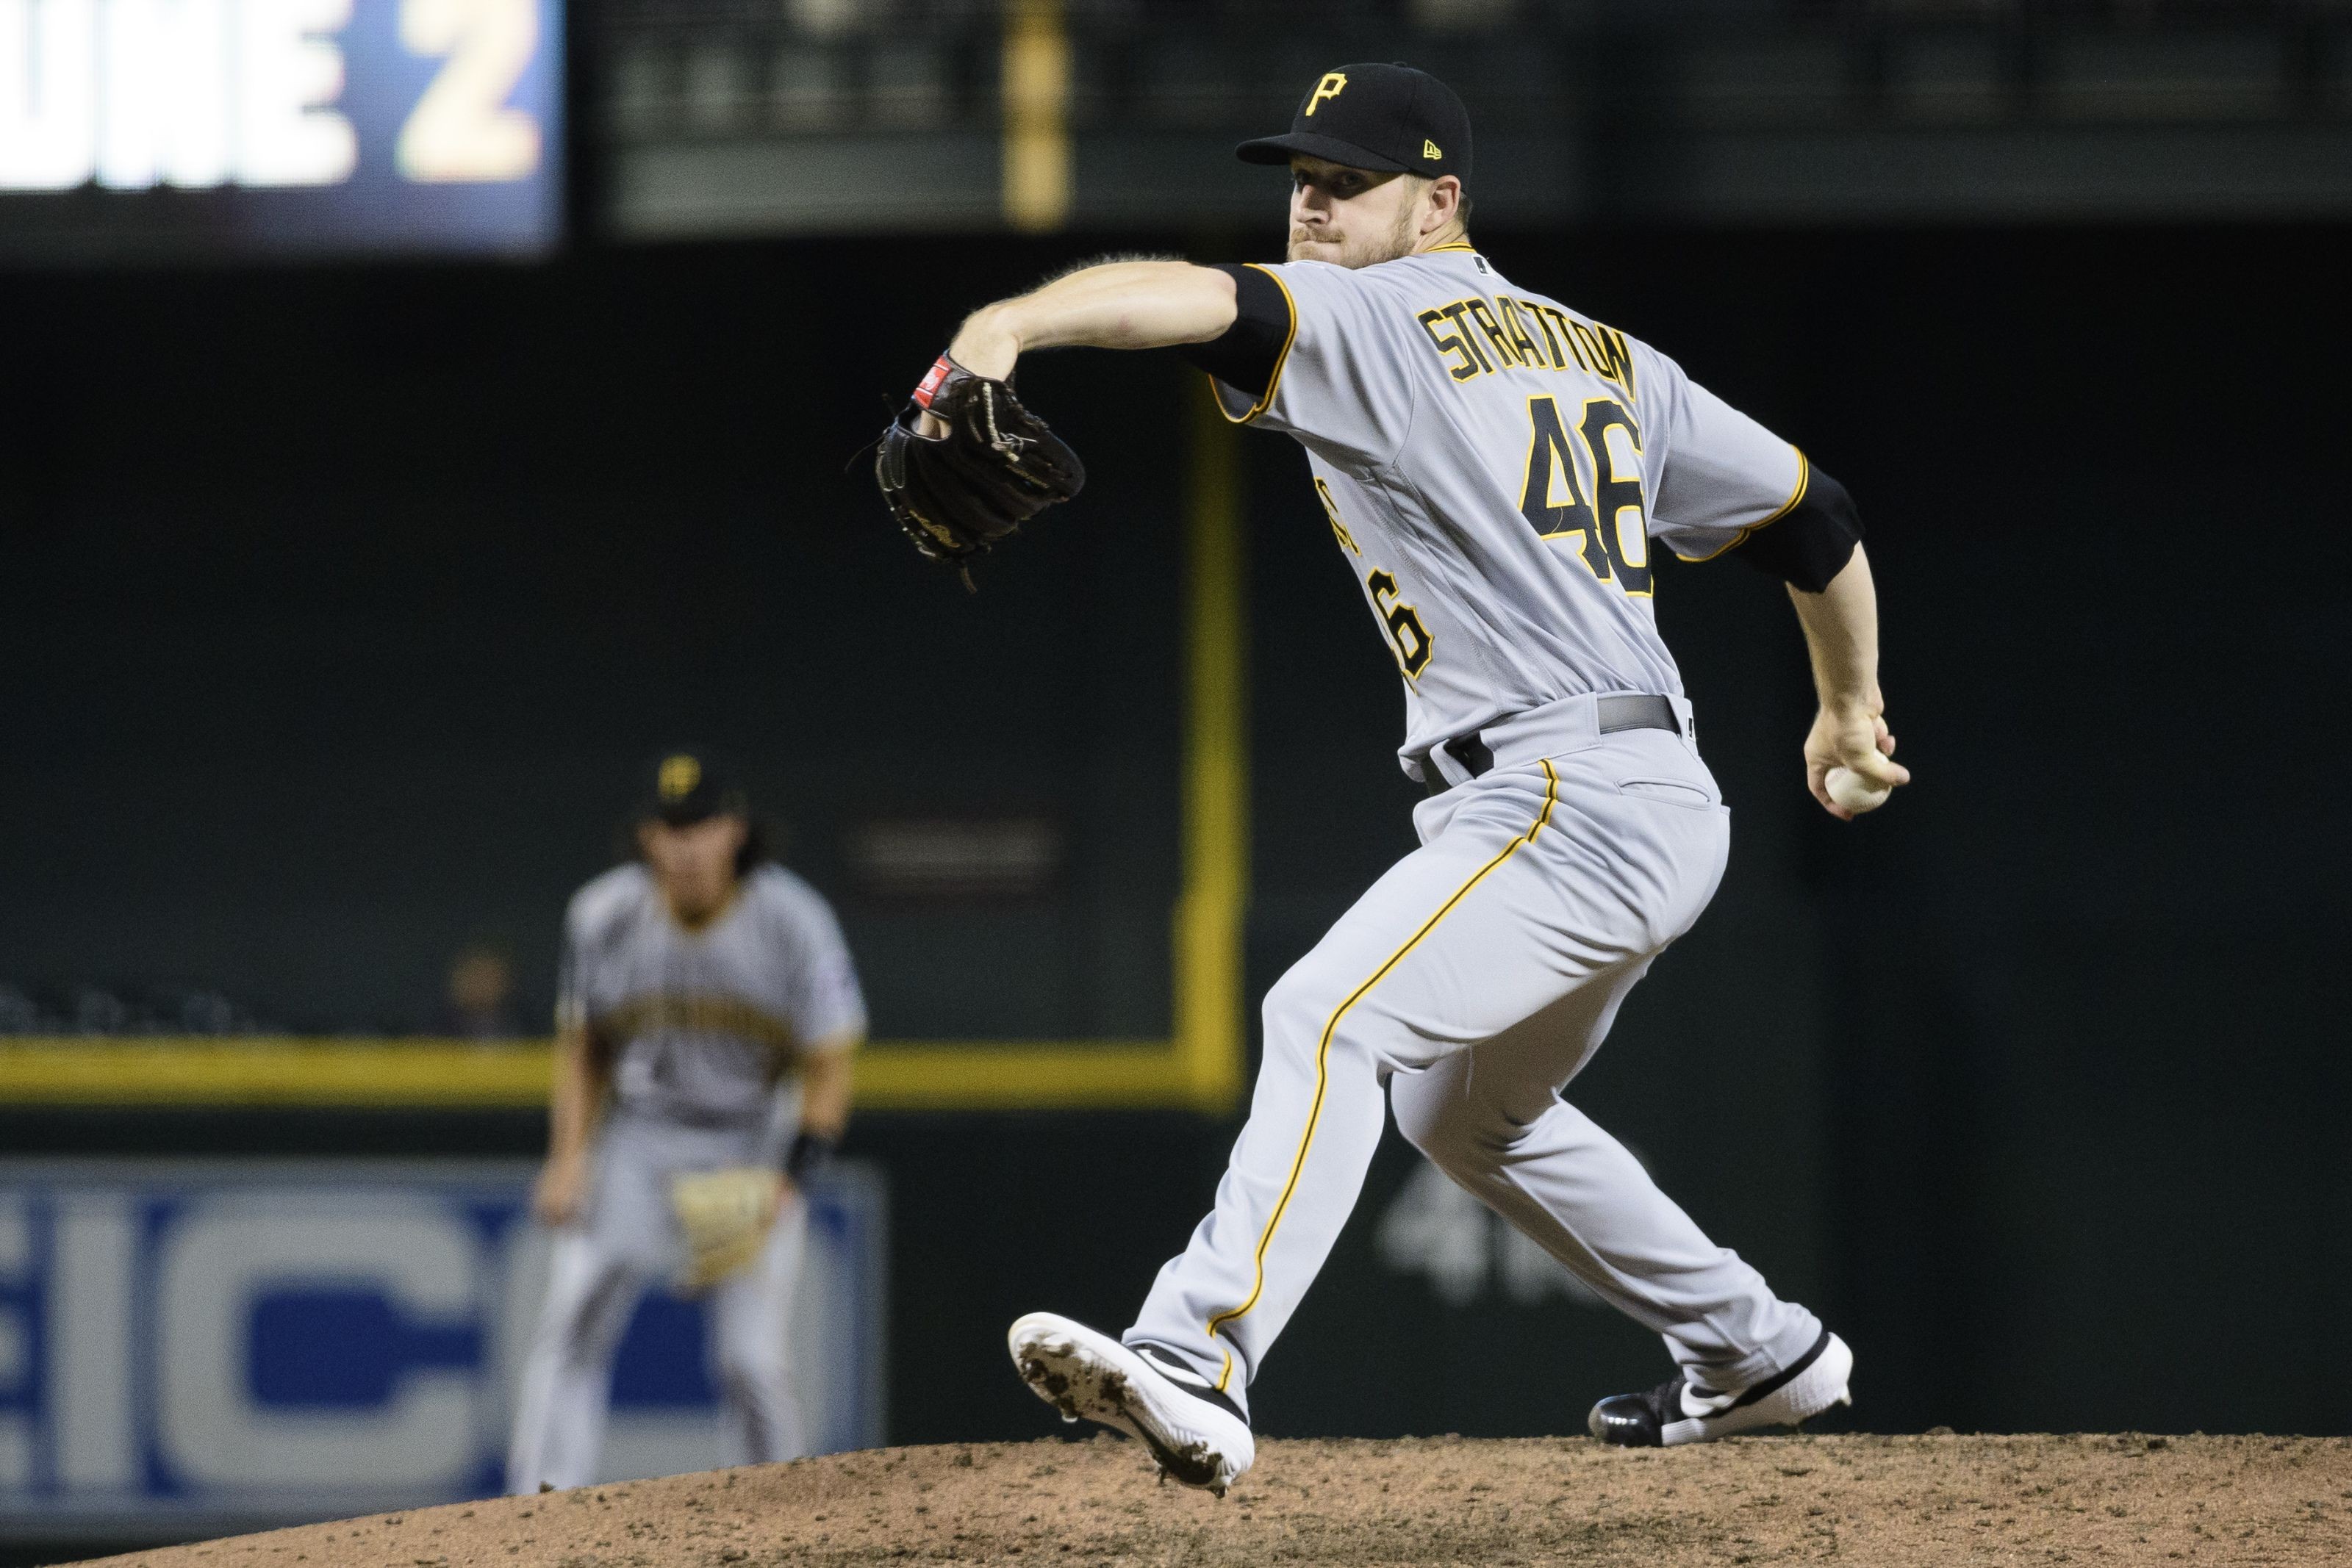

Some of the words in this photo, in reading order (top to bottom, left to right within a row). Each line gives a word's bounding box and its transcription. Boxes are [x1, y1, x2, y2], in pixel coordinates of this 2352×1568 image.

[395, 0, 542, 184] 2
[1305, 73, 1347, 116] P
[1418, 295, 1636, 402] STRATTON
[1518, 395, 1654, 599] 46
[1367, 566, 1435, 695] 6
